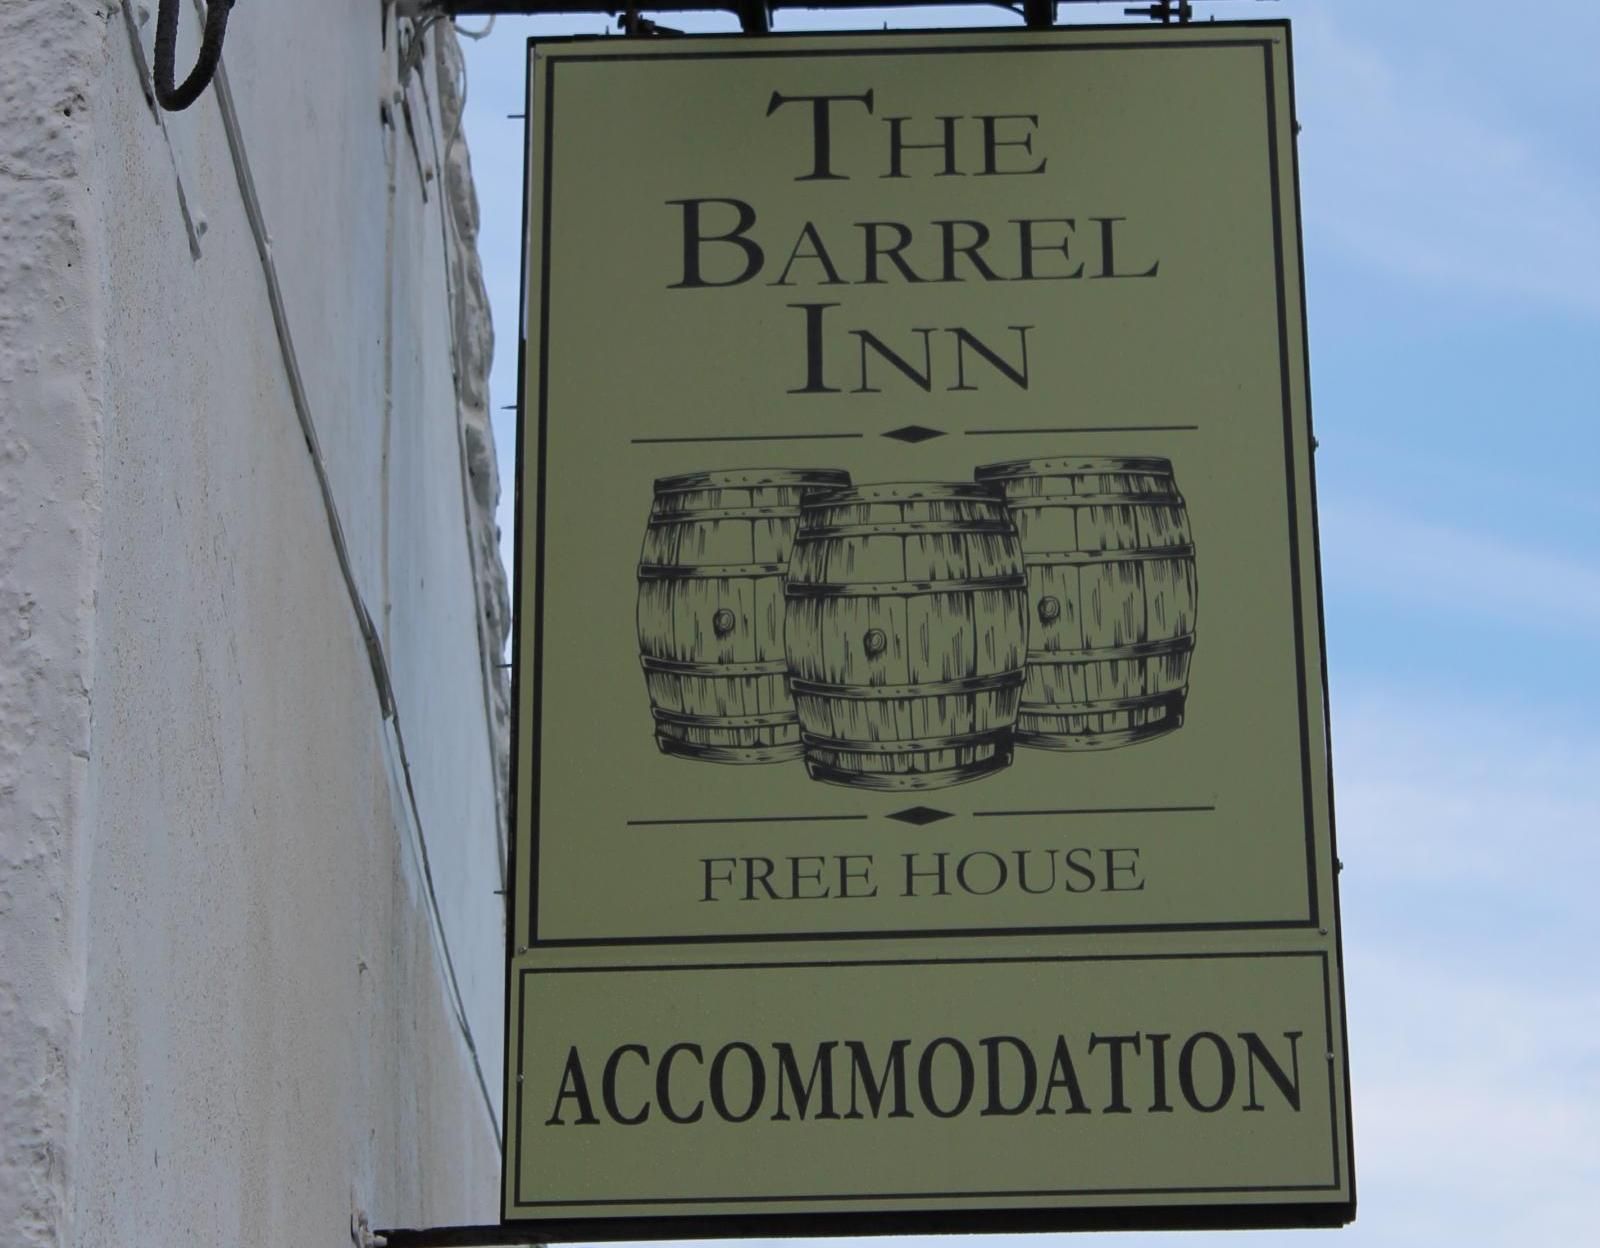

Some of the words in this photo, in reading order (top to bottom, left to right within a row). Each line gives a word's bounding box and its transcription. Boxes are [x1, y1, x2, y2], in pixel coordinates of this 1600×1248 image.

[766, 88, 1047, 181] THE
[665, 198, 1159, 289] BARREL
[787, 303, 1034, 393] INN
[699, 854, 877, 903] FREE
[901, 848, 1146, 898] HOUSE
[545, 1030, 1303, 1126] ACCOMMODATION
